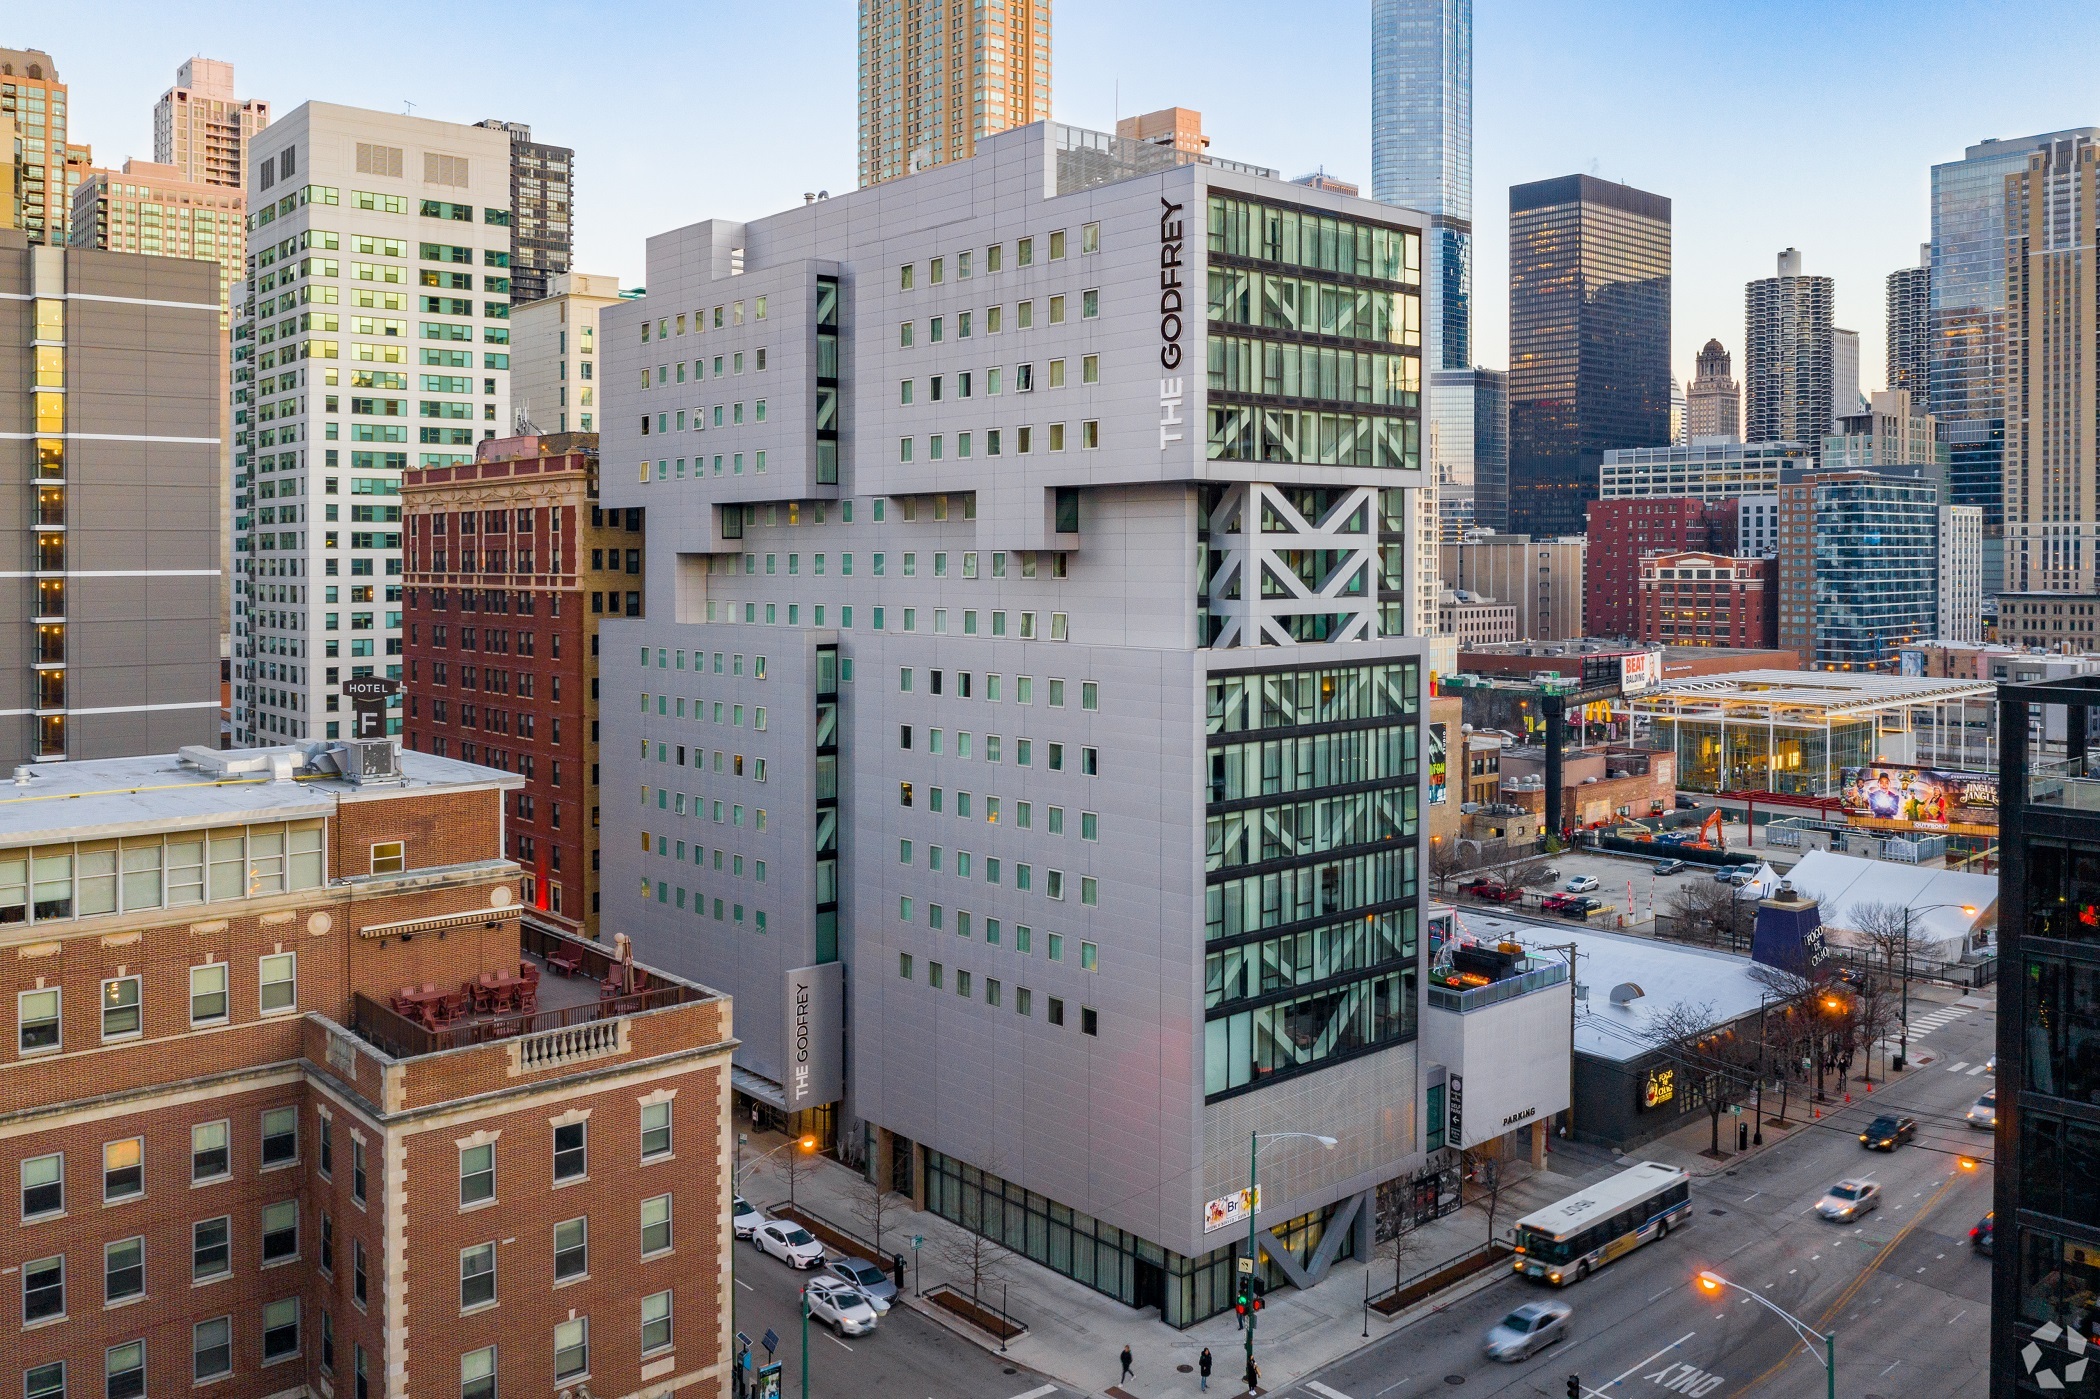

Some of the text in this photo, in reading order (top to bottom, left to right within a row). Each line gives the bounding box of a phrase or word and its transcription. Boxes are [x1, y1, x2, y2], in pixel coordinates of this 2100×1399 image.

[1160, 197, 1183, 450] THE GODFREY
[1625, 656, 1645, 674] BEAT
[1625, 673, 1645, 684] BALDING
[349, 684, 389, 693] HOTEL
[361, 712, 378, 734] F
[1960, 791, 1999, 806] JANGLE
[1963, 783, 1998, 796] JINGLE
[1804, 925, 1823, 946] FOGO
[795, 983, 809, 1100] THE GODFREY
[1502, 1107, 1536, 1126] PARKING
[1227, 1200, 1239, 1213] Br
[1643, 1361, 1725, 1398] ONLY
